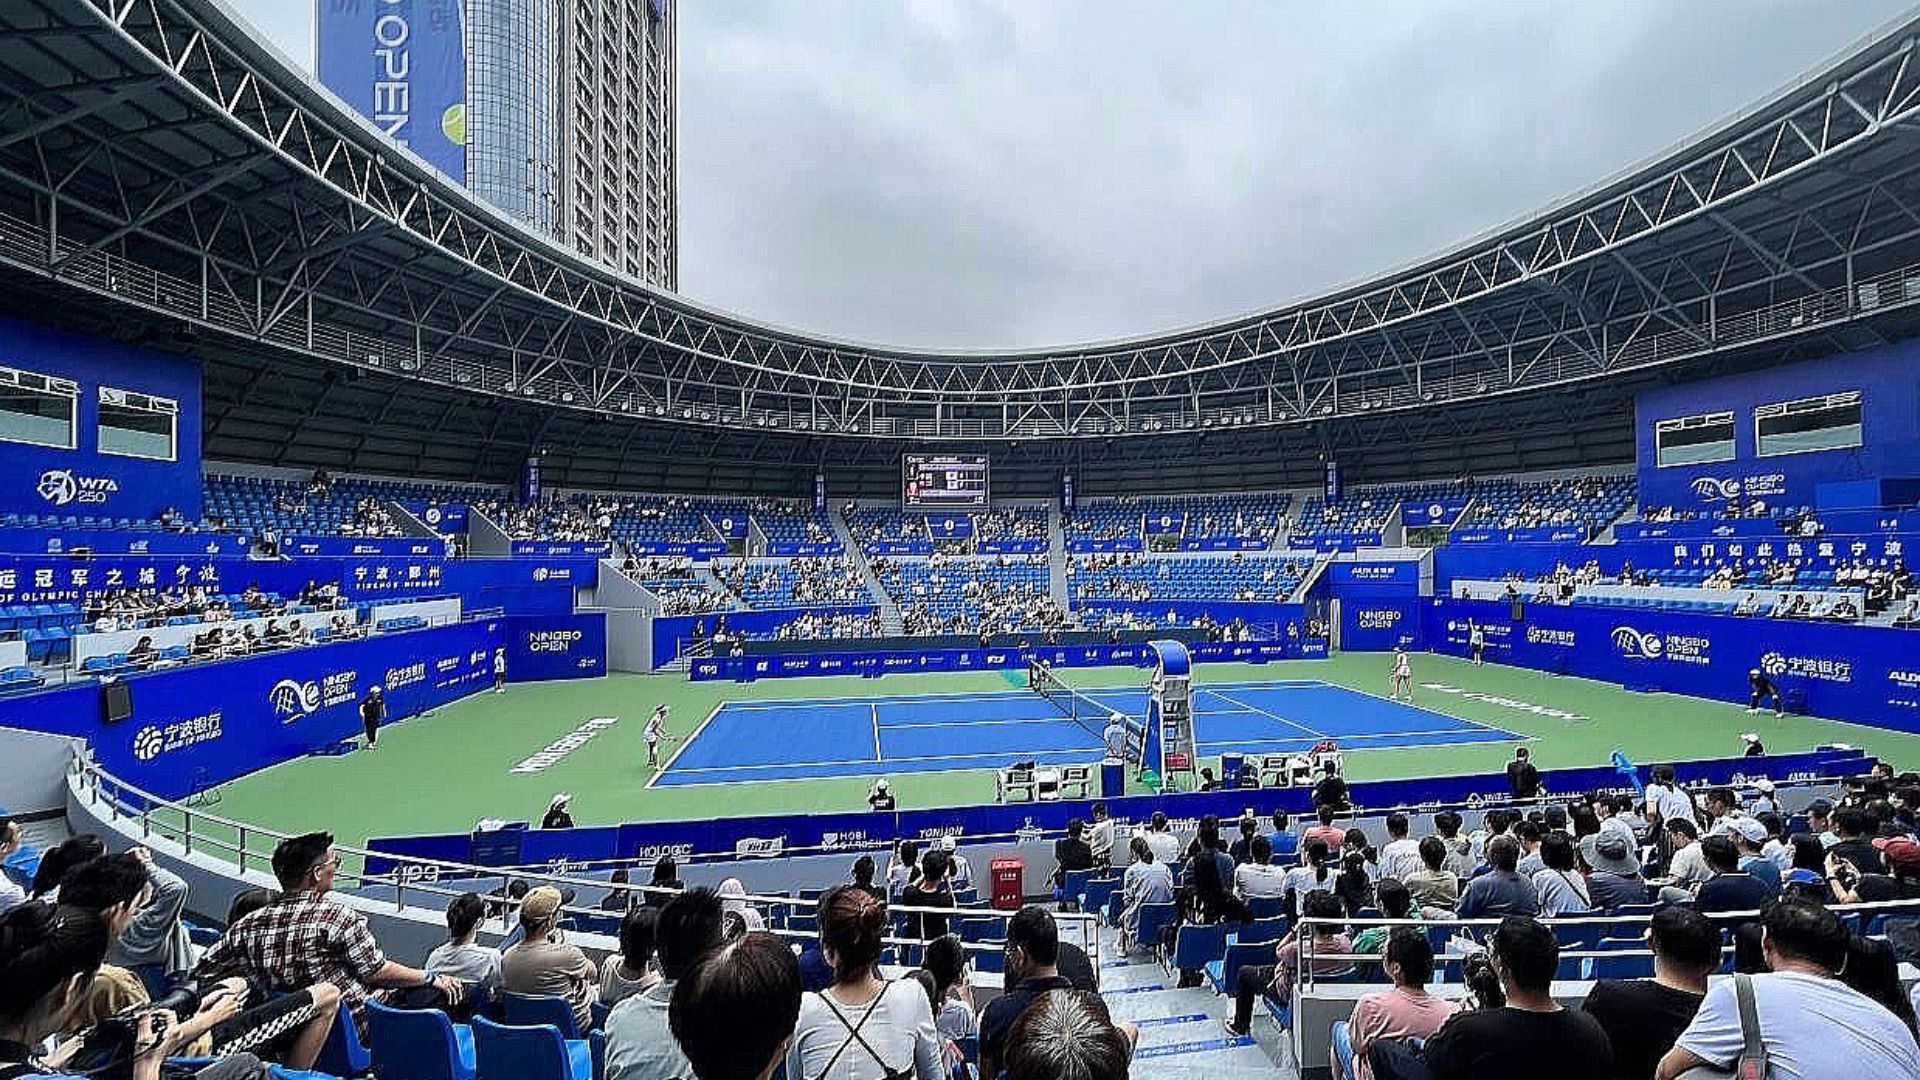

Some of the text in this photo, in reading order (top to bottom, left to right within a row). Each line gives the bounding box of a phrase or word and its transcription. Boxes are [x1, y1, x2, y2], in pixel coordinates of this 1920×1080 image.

[374, 15, 410, 149] OPEN
[78, 477, 119, 492] WTA
[78, 491, 107, 503] 250
[1360, 620, 1392, 628] OPEN
[529, 631, 583, 642] NINGBO
[1666, 634, 1710, 649] NINGBO
[529, 641, 569, 652] OPEN
[1666, 645, 1699, 656] OPEN
[1787, 657, 1851, 676] 宁波银行
[323, 683, 348, 698] OPEN
[164, 713, 221, 742] 宁波银行
[840, 831, 867, 841] HOBI
